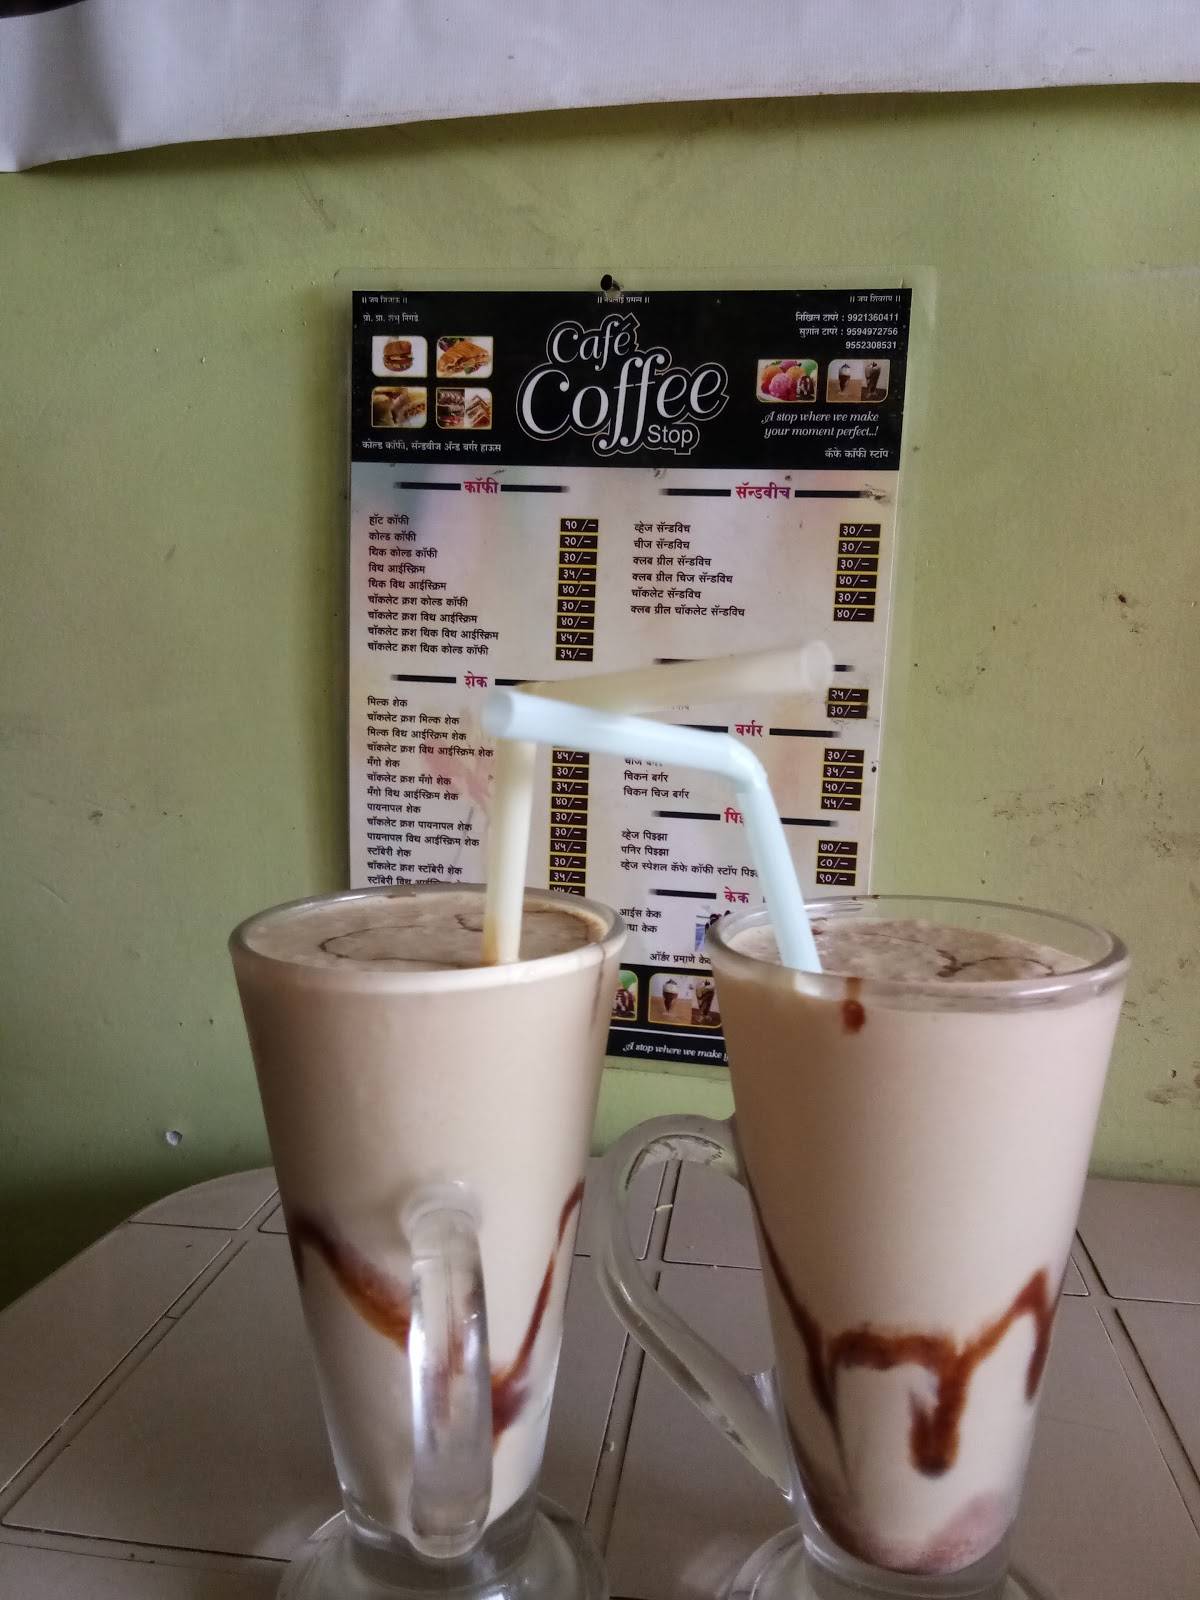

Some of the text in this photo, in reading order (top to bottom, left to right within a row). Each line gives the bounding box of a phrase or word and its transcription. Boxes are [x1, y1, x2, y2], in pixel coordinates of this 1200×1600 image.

[848, 314, 899, 322] 9921360411
[847, 328, 898, 336] 9594972756
[553, 321, 631, 372] Café
[523, 354, 721, 450] Coffee
[761, 411, 774, 424] A
[777, 413, 798, 424] stop
[800, 411, 831, 422] where
[850, 411, 879, 422] make
[648, 425, 692, 447] Stop
[764, 427, 790, 440] your
[792, 427, 834, 436] moment
[845, 447, 866, 458] कॉफी
[870, 448, 889, 458] स्टॉप
[464, 478, 499, 494] कॉफी
[369, 514, 409, 526] हॉट कॉफी
[634, 521, 653, 534] व्हेज
[369, 530, 416, 541] कोल्ड कॉफी
[634, 538, 652, 549] चीज
[391, 546, 412, 558] कोल्ड
[416, 547, 438, 558] कॉफी
[369, 562, 384, 572] विथ
[633, 556, 653, 565] क्लब
[390, 579, 405, 589] विथ
[632, 573, 652, 581] क्लब
[677, 572, 695, 583] चिज
[632, 587, 664, 598] चॉकलेट
[368, 593, 468, 607] चॉकलेट क्रश कोल्ड कॉफी
[368, 609, 398, 620] चॉकलेट
[402, 612, 417, 621] क्रश
[421, 611, 436, 621] विथ
[631, 605, 651, 614] क्लब
[676, 605, 707, 616] चॉकलेट
[368, 625, 398, 636] चॉकलेट
[402, 628, 417, 637] क्रश
[442, 628, 457, 639] विथ
[368, 640, 398, 651] चॉकलेट
[402, 644, 417, 652] क्रश
[442, 643, 463, 655] कोल्ड
[467, 645, 488, 656] कॉफी
[465, 671, 488, 688] शेक
[368, 696, 408, 708] मिल्क शेक
[367, 711, 460, 725] चॉकलेट क्रश मिल्क शेक
[368, 726, 389, 736] मिल्क
[393, 727, 407, 737] विथ
[452, 730, 467, 741] शेक
[736, 720, 763, 737] बर्गर
[367, 741, 397, 753] चॉकलेट
[400, 745, 415, 754] क्रश
[419, 744, 434, 755] विथ
[479, 747, 494, 757] शेक
[385, 759, 400, 768] शेक
[367, 772, 452, 786] चॉकलेट क्रश शेक
[624, 770, 669, 782] चिकन बर्गर
[385, 787, 400, 797] विथ
[444, 791, 459, 801] शेक
[624, 786, 690, 799] चिकन चिज बर्गर
[367, 803, 421, 814] पायनापल शेक
[367, 817, 472, 832] चॉकलेट क्रश पायनापल शेक
[367, 832, 402, 842] पायनापल
[406, 833, 421, 843] विथ
[465, 836, 479, 847] शेक
[622, 828, 639, 840] व्हेज
[397, 847, 412, 857] शेक
[621, 844, 641, 855] पनिर
[368, 861, 462, 875] चॉकलेट क्रश शेक
[621, 859, 638, 871] व्हेज
[671, 862, 688, 872] कॅफे
[692, 863, 714, 874] कॉफी
[718, 865, 737, 876] स्टॉप
[724, 886, 749, 903] केक
[619, 908, 662, 919] आईस केक
[642, 923, 657, 933] केक
[636, 1044, 653, 1054] stop
[655, 1045, 681, 1055] where
[683, 1048, 697, 1056] we
[698, 1050, 723, 1059] make
